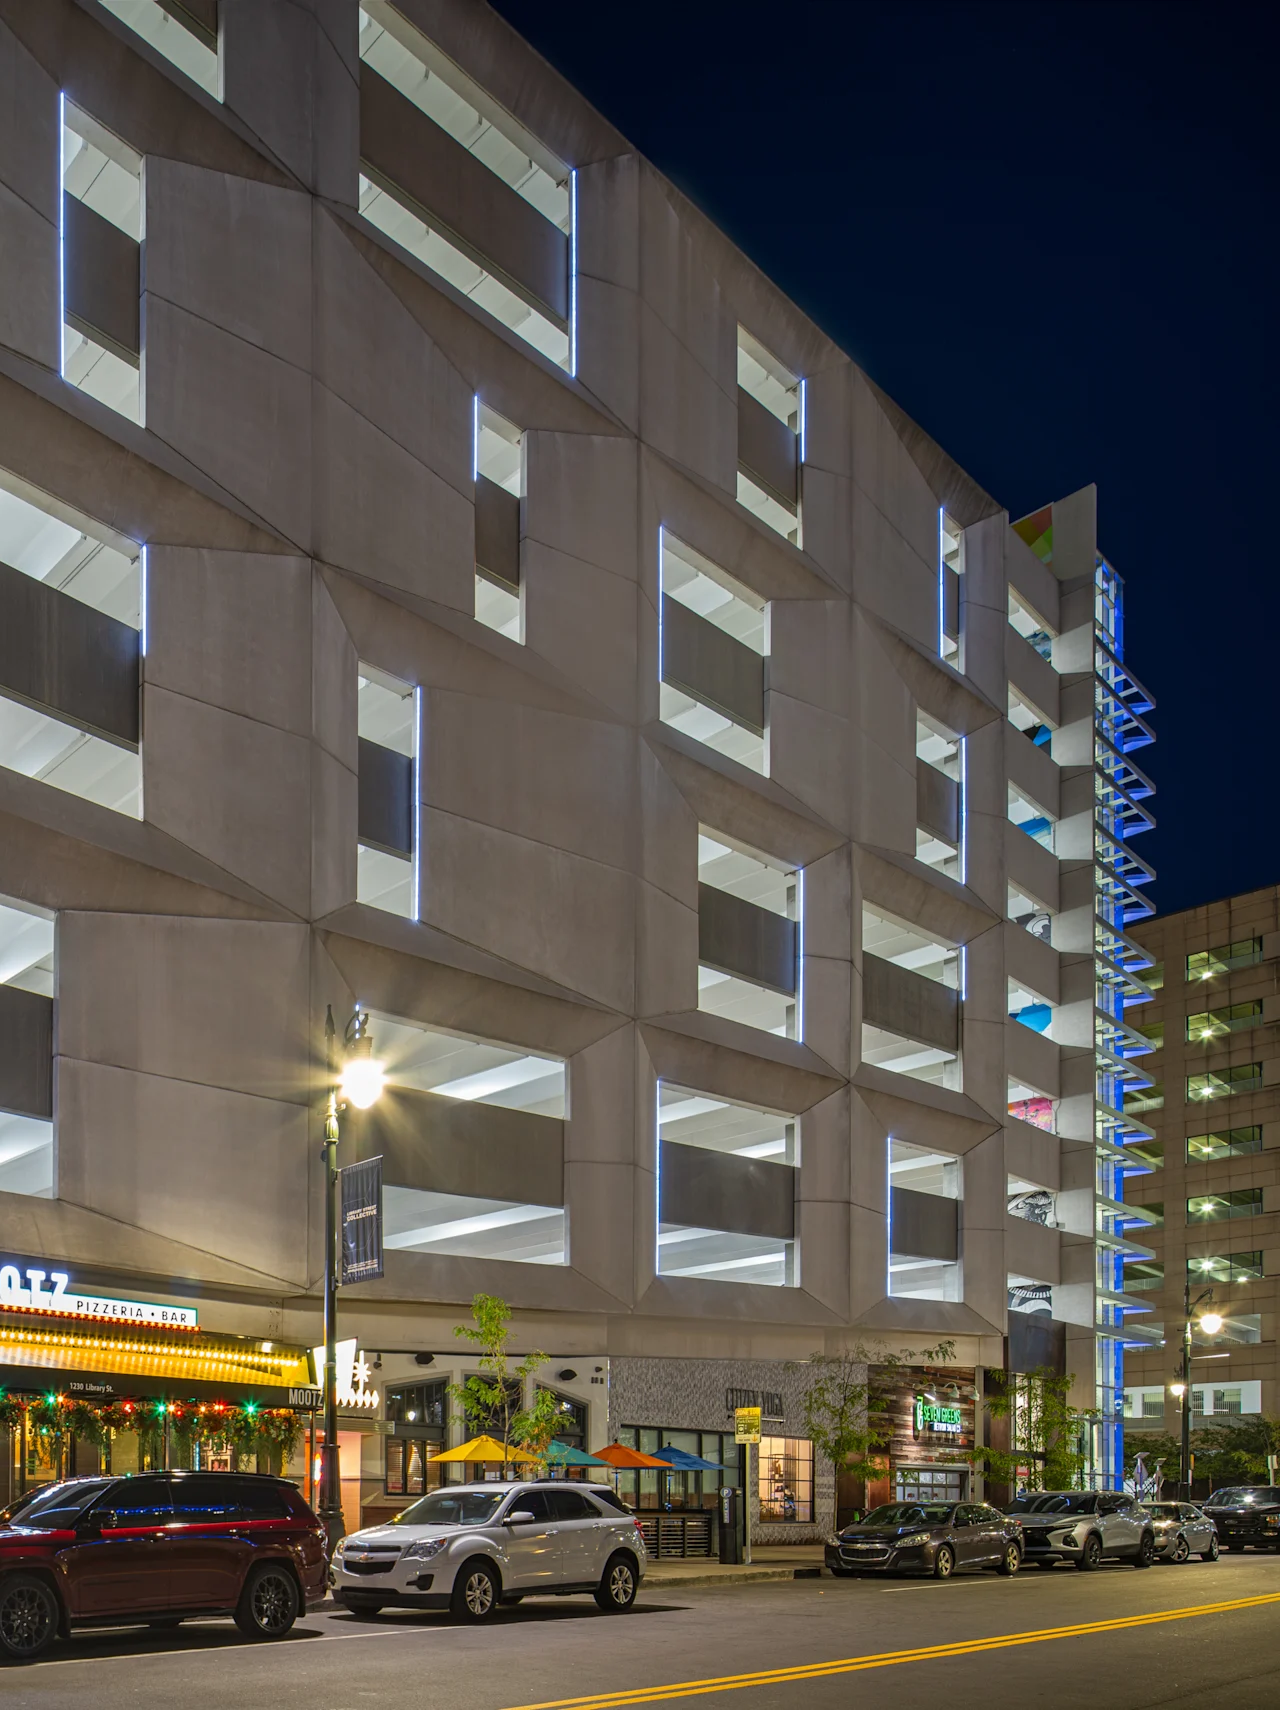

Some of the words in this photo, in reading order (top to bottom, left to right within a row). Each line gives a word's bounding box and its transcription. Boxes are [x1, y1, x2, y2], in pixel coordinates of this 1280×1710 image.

[346, 1209, 378, 1222] COLLECTIVE
[76, 1300, 144, 1319] PIZZERIA
[161, 1310, 189, 1324] BAR
[70, 1382, 84, 1391] 1230
[85, 1383, 106, 1394] Library
[106, 1385, 114, 1393] St.
[288, 1388, 324, 1407] MOOTZ
[923, 1405, 941, 1422] SEVEN
[941, 1408, 961, 1423] GREENS
